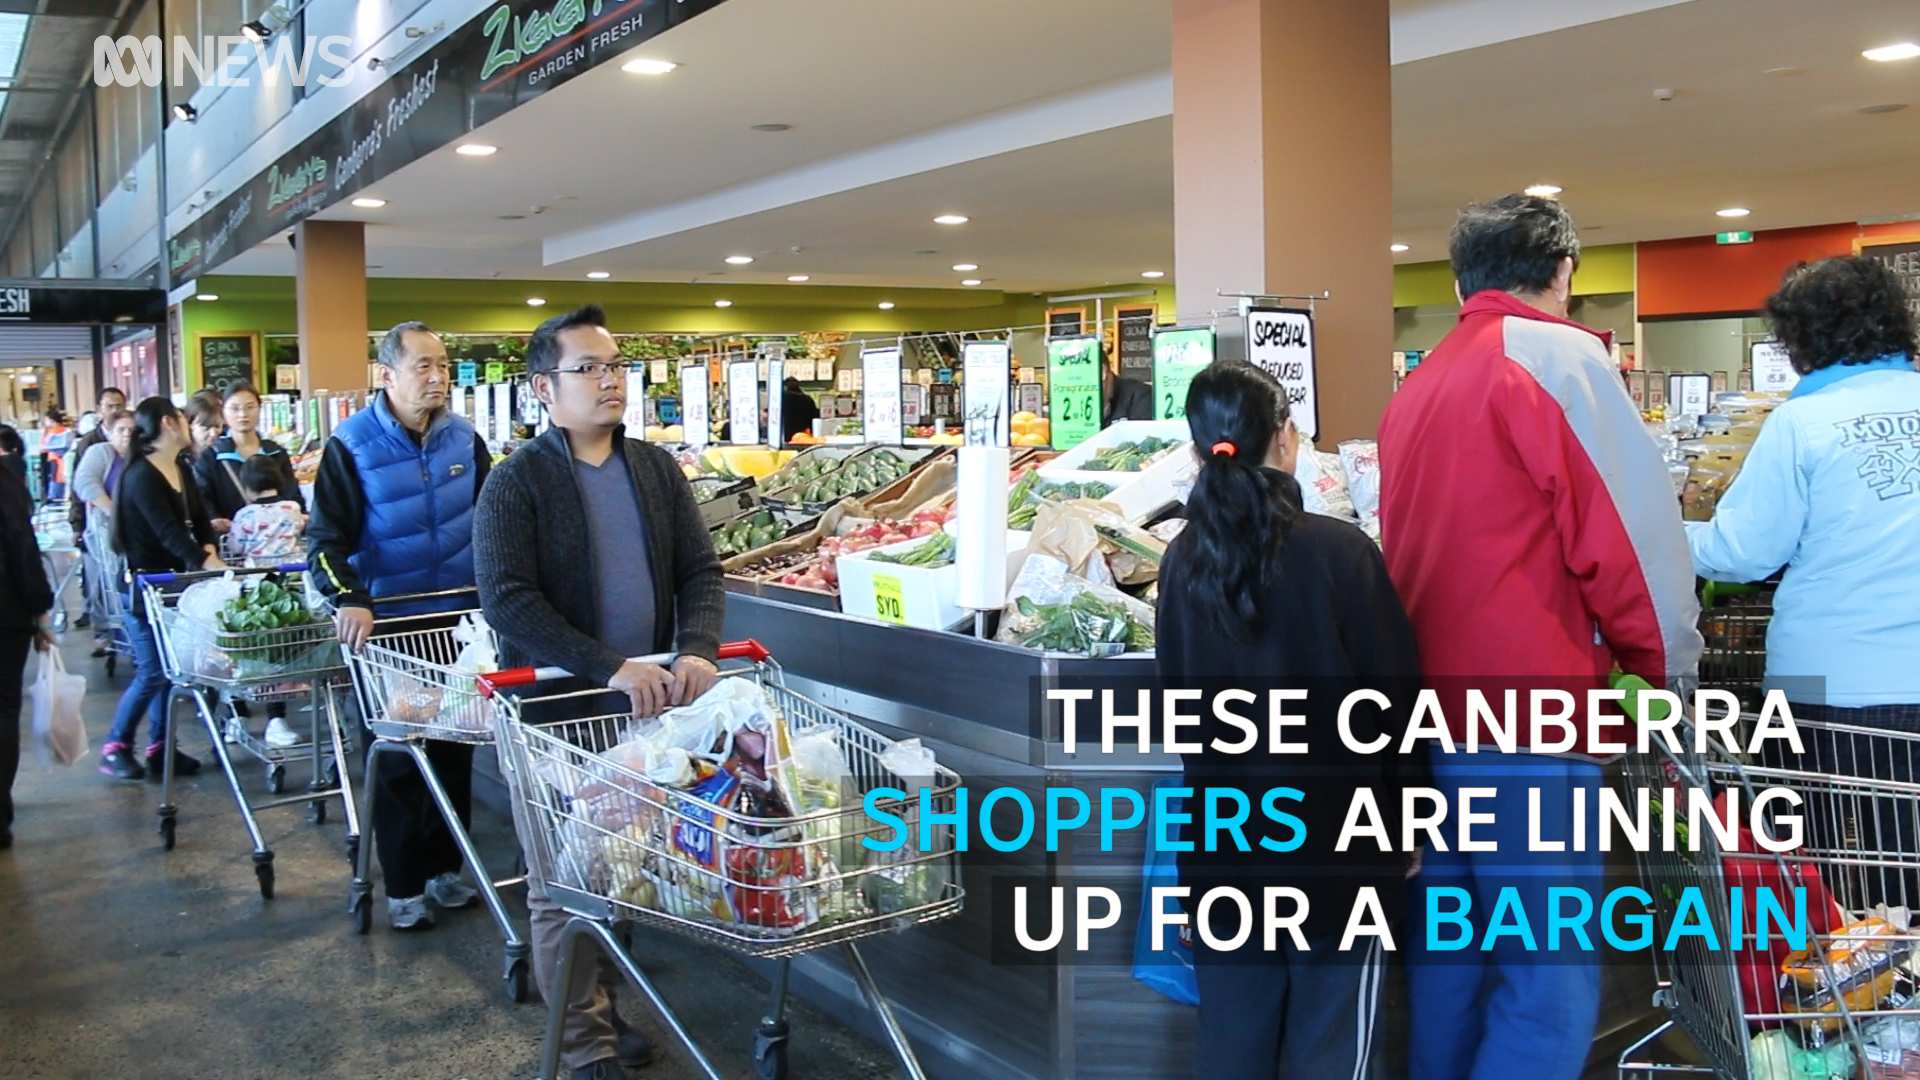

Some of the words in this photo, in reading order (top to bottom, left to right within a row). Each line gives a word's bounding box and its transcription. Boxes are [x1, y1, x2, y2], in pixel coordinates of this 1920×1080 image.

[528, 47, 586, 86] GARDEN
[590, 13, 644, 52] FRESH
[386, 58, 439, 137] Freshest
[1254, 319, 1308, 348] SPECIAL
[1261, 359, 1305, 381] REDUCED
[1062, 397, 1072, 421] 2
[1164, 392, 1174, 420] 2
[876, 594, 901, 619] SYD
